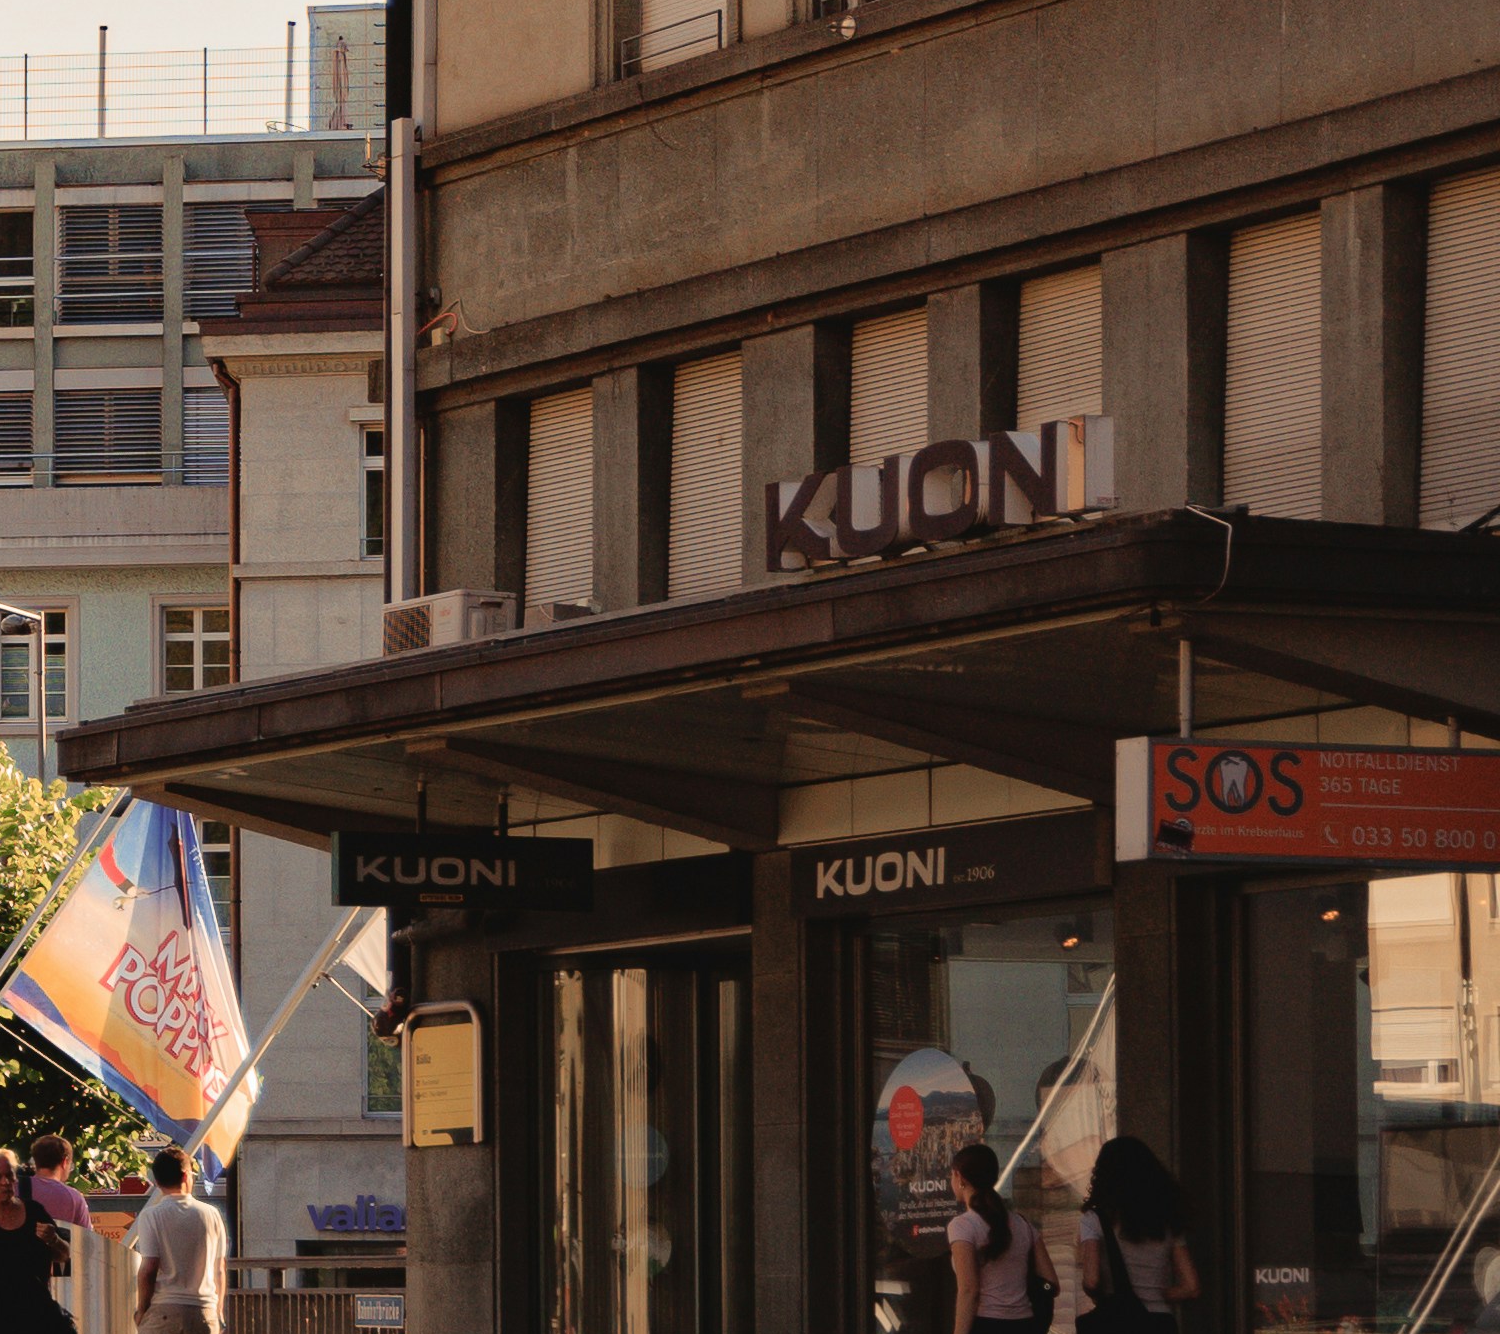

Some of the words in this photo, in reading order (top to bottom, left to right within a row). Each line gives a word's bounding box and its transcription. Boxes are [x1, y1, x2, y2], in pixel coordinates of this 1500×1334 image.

[766, 415, 1112, 573] KUONI
[1319, 752, 1461, 772] NOTFALLDIENST
[1164, 747, 1304, 816] SOS
[1319, 776, 1353, 793] 365
[1358, 777, 1403, 795] TAGE
[1352, 826, 1394, 846] 033
[1401, 827, 1428, 847] 50
[1435, 829, 1476, 849] 800
[356, 855, 517, 886] KUONI
[816, 847, 945, 899] KUONI
[966, 864, 996, 882] 1906
[909, 1179, 947, 1193] KUONI
[1256, 1267, 1309, 1284] KUONI
